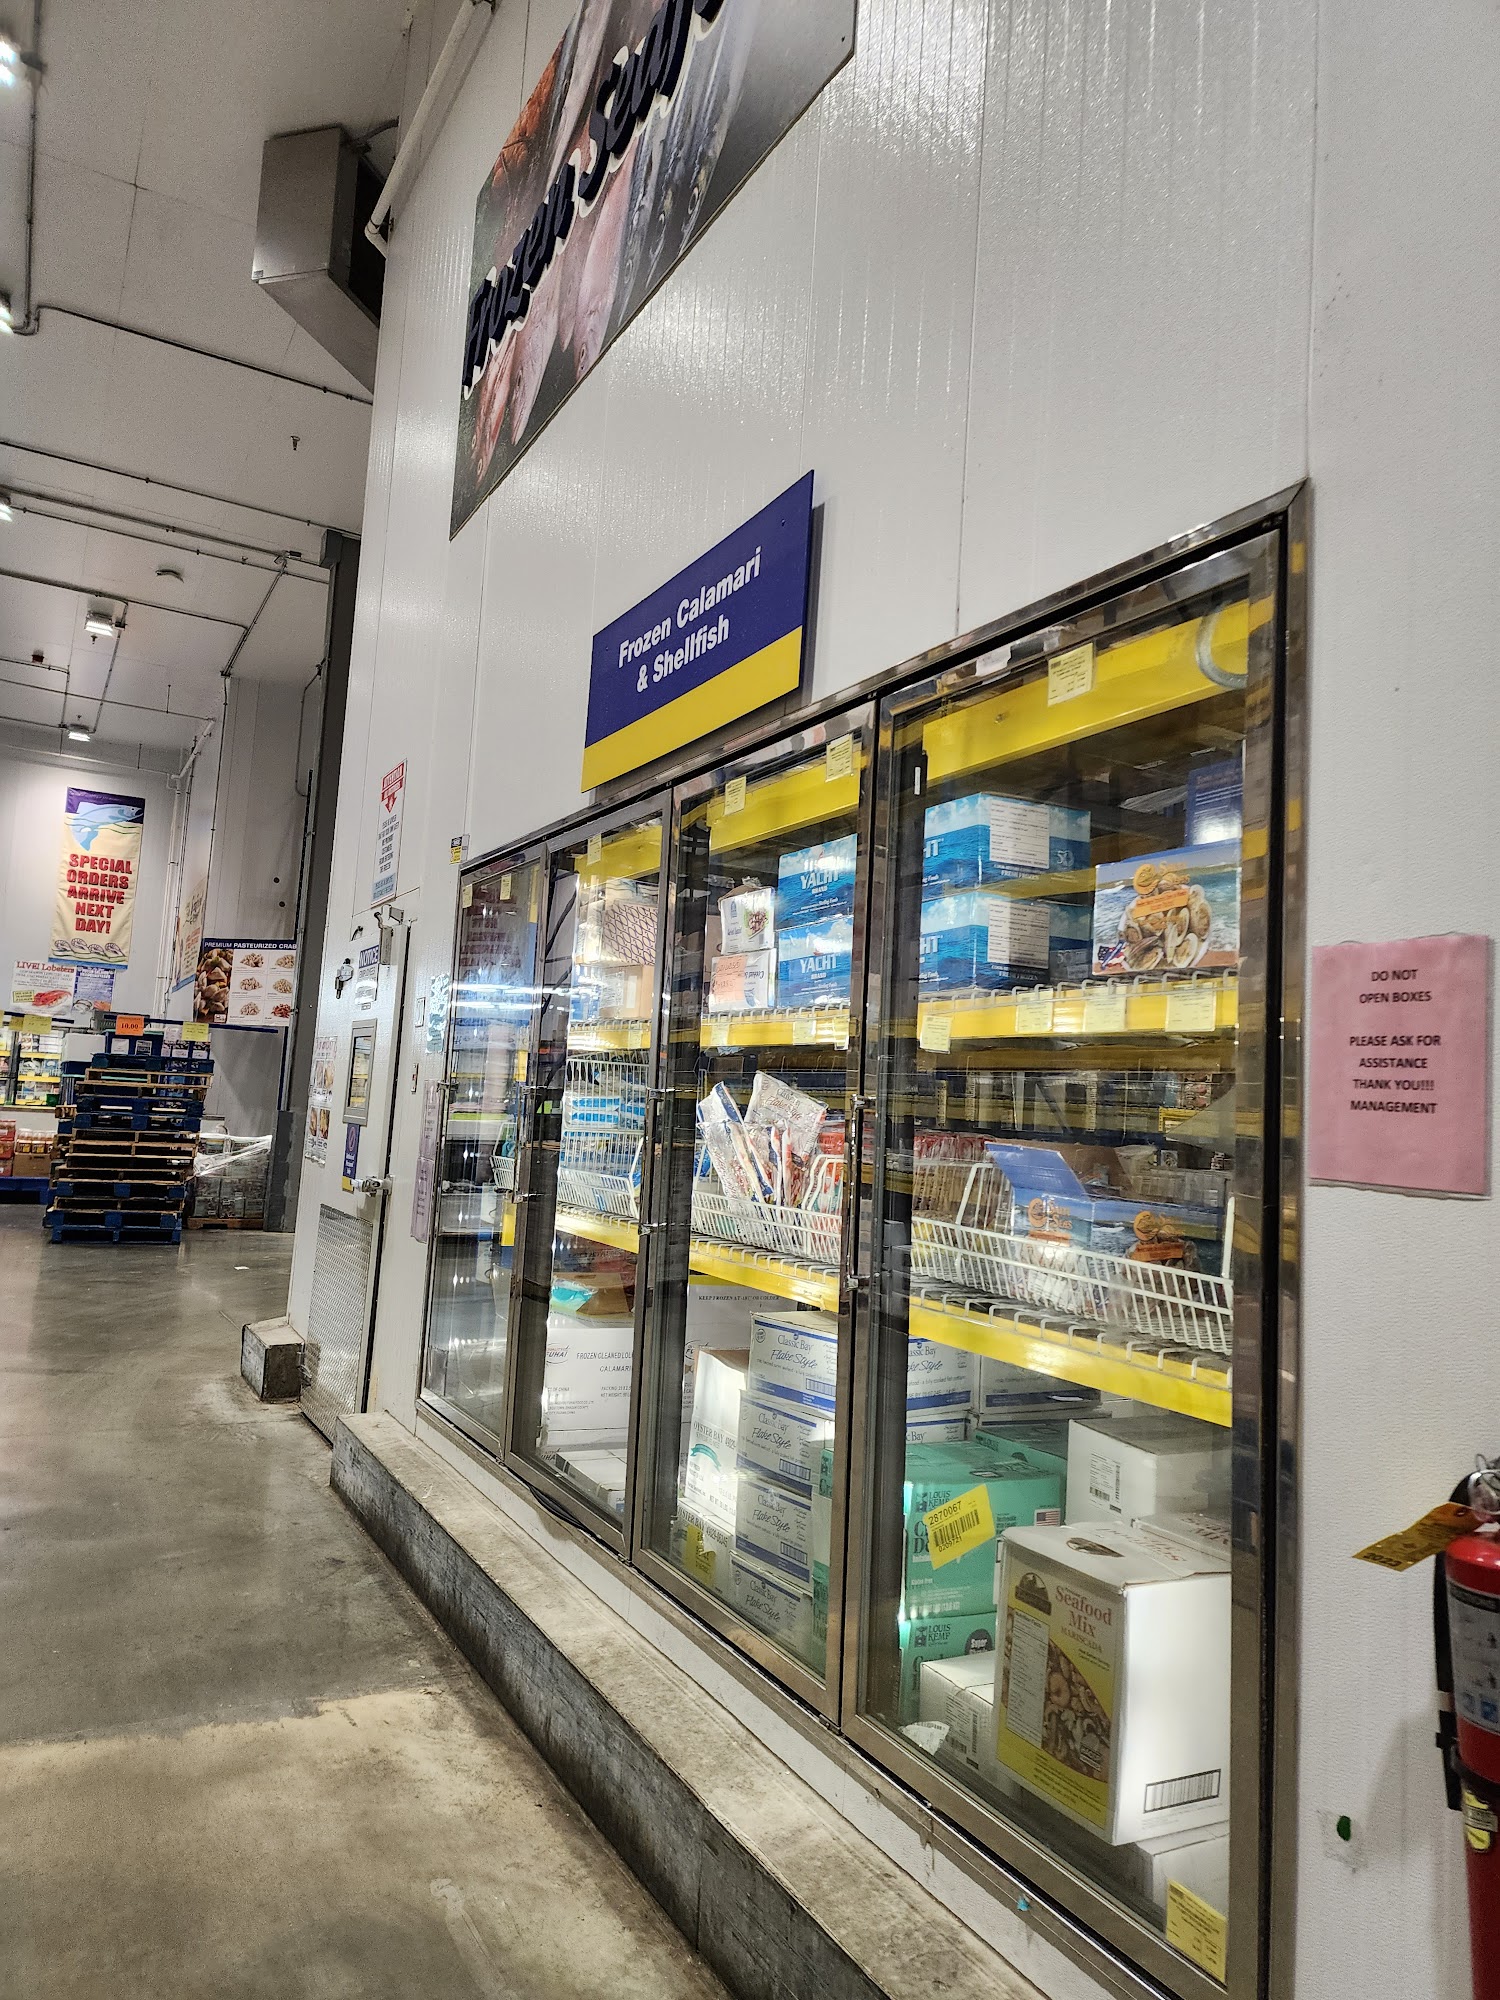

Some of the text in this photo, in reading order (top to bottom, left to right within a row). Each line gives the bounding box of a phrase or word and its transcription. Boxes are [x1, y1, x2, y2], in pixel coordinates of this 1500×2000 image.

[463, 0, 722, 378] Frozen Sea
[618, 545, 762, 669] Frozen Calamari
[636, 614, 730, 693] & Shellfish
[68, 853, 132, 875] SPECIAL
[66, 869, 129, 889] ORDERS
[800, 869, 839, 890] YACHT
[67, 885, 125, 905] ARRIVE
[75, 902, 114, 918] NEXT
[75, 917, 111, 934] DAY!
[41, 962, 75, 974] Lobsters
[800, 954, 837, 974] YACHT
[1371, 969, 1418, 982] DO NOT
[1359, 991, 1432, 1004] OPEN BOXES
[1349, 1035, 1441, 1047] PLEASE ASK FOR
[1359, 1057, 1428, 1069] ASSISTANCE
[1353, 1078, 1392, 1091] THANK
[1350, 1100, 1438, 1115] MANAGEMENT
[777, 1334, 814, 1355] Classic Bay
[925, 1346, 938, 1358] Bay
[770, 1349, 818, 1370] Flake Style
[919, 1360, 943, 1374] Style
[693, 1421, 713, 1438] OYSTER
[713, 1430, 725, 1444] BAY
[752, 1427, 792, 1450] Flake Style
[911, 1431, 926, 1442] Bay
[929, 1490, 952, 1499] LOUIS
[752, 1509, 791, 1533] Flake Style
[928, 1501, 962, 1526] 2870067
[1055, 1585, 1113, 1626] Seafood
[928, 1624, 951, 1633] LOUIS
[1069, 1610, 1097, 1638] Mix
[928, 1632, 951, 1642] KEMP
[1061, 1626, 1103, 1654] MARISCADA
